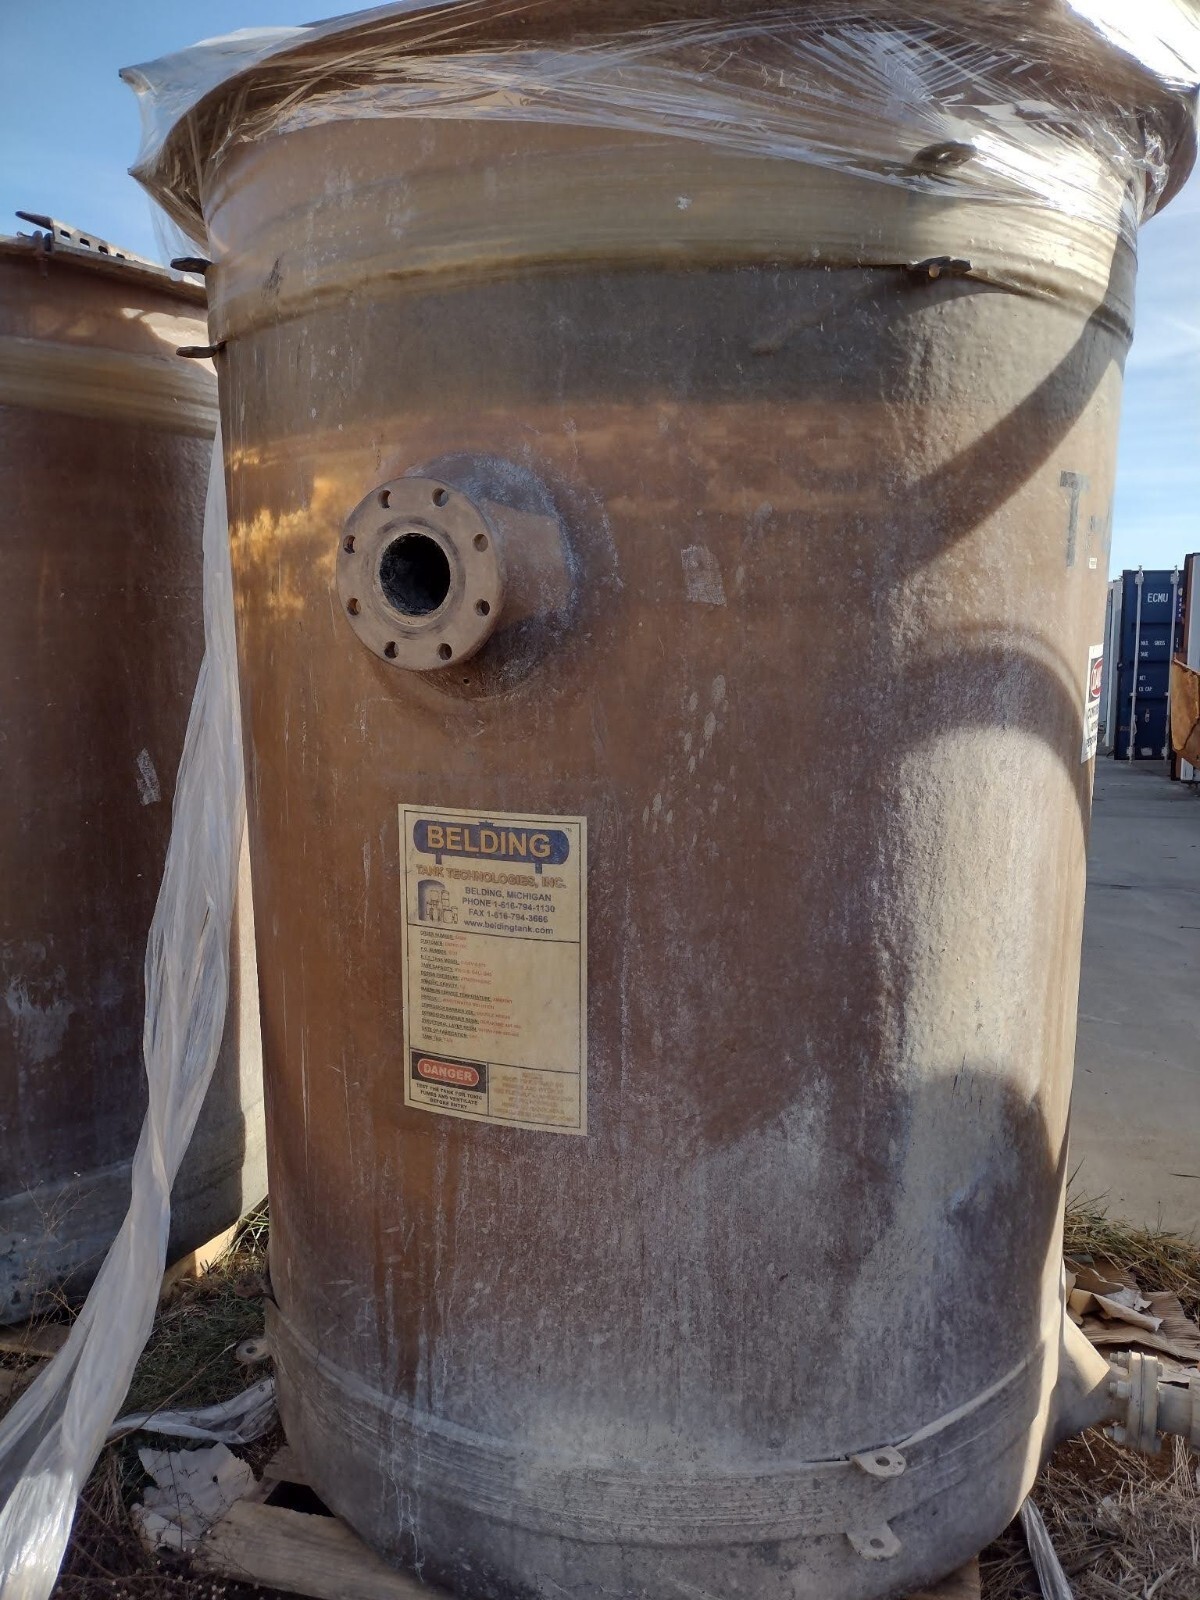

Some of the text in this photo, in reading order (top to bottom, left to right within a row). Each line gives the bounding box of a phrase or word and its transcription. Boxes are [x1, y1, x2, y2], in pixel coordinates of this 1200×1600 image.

[1147, 593, 1169, 603] ECMU
[427, 825, 551, 858] BELDING
[416, 864, 567, 889] TANK TECHNOLOGIES, INC.
[465, 886, 552, 902] BELDING, MICHIGAN
[462, 897, 556, 913] PHONE 1-616-794-1130
[468, 908, 484, 917] FAX
[464, 920, 554, 935] www.beldingtank.com
[423, 1063, 473, 1081] DANGER
